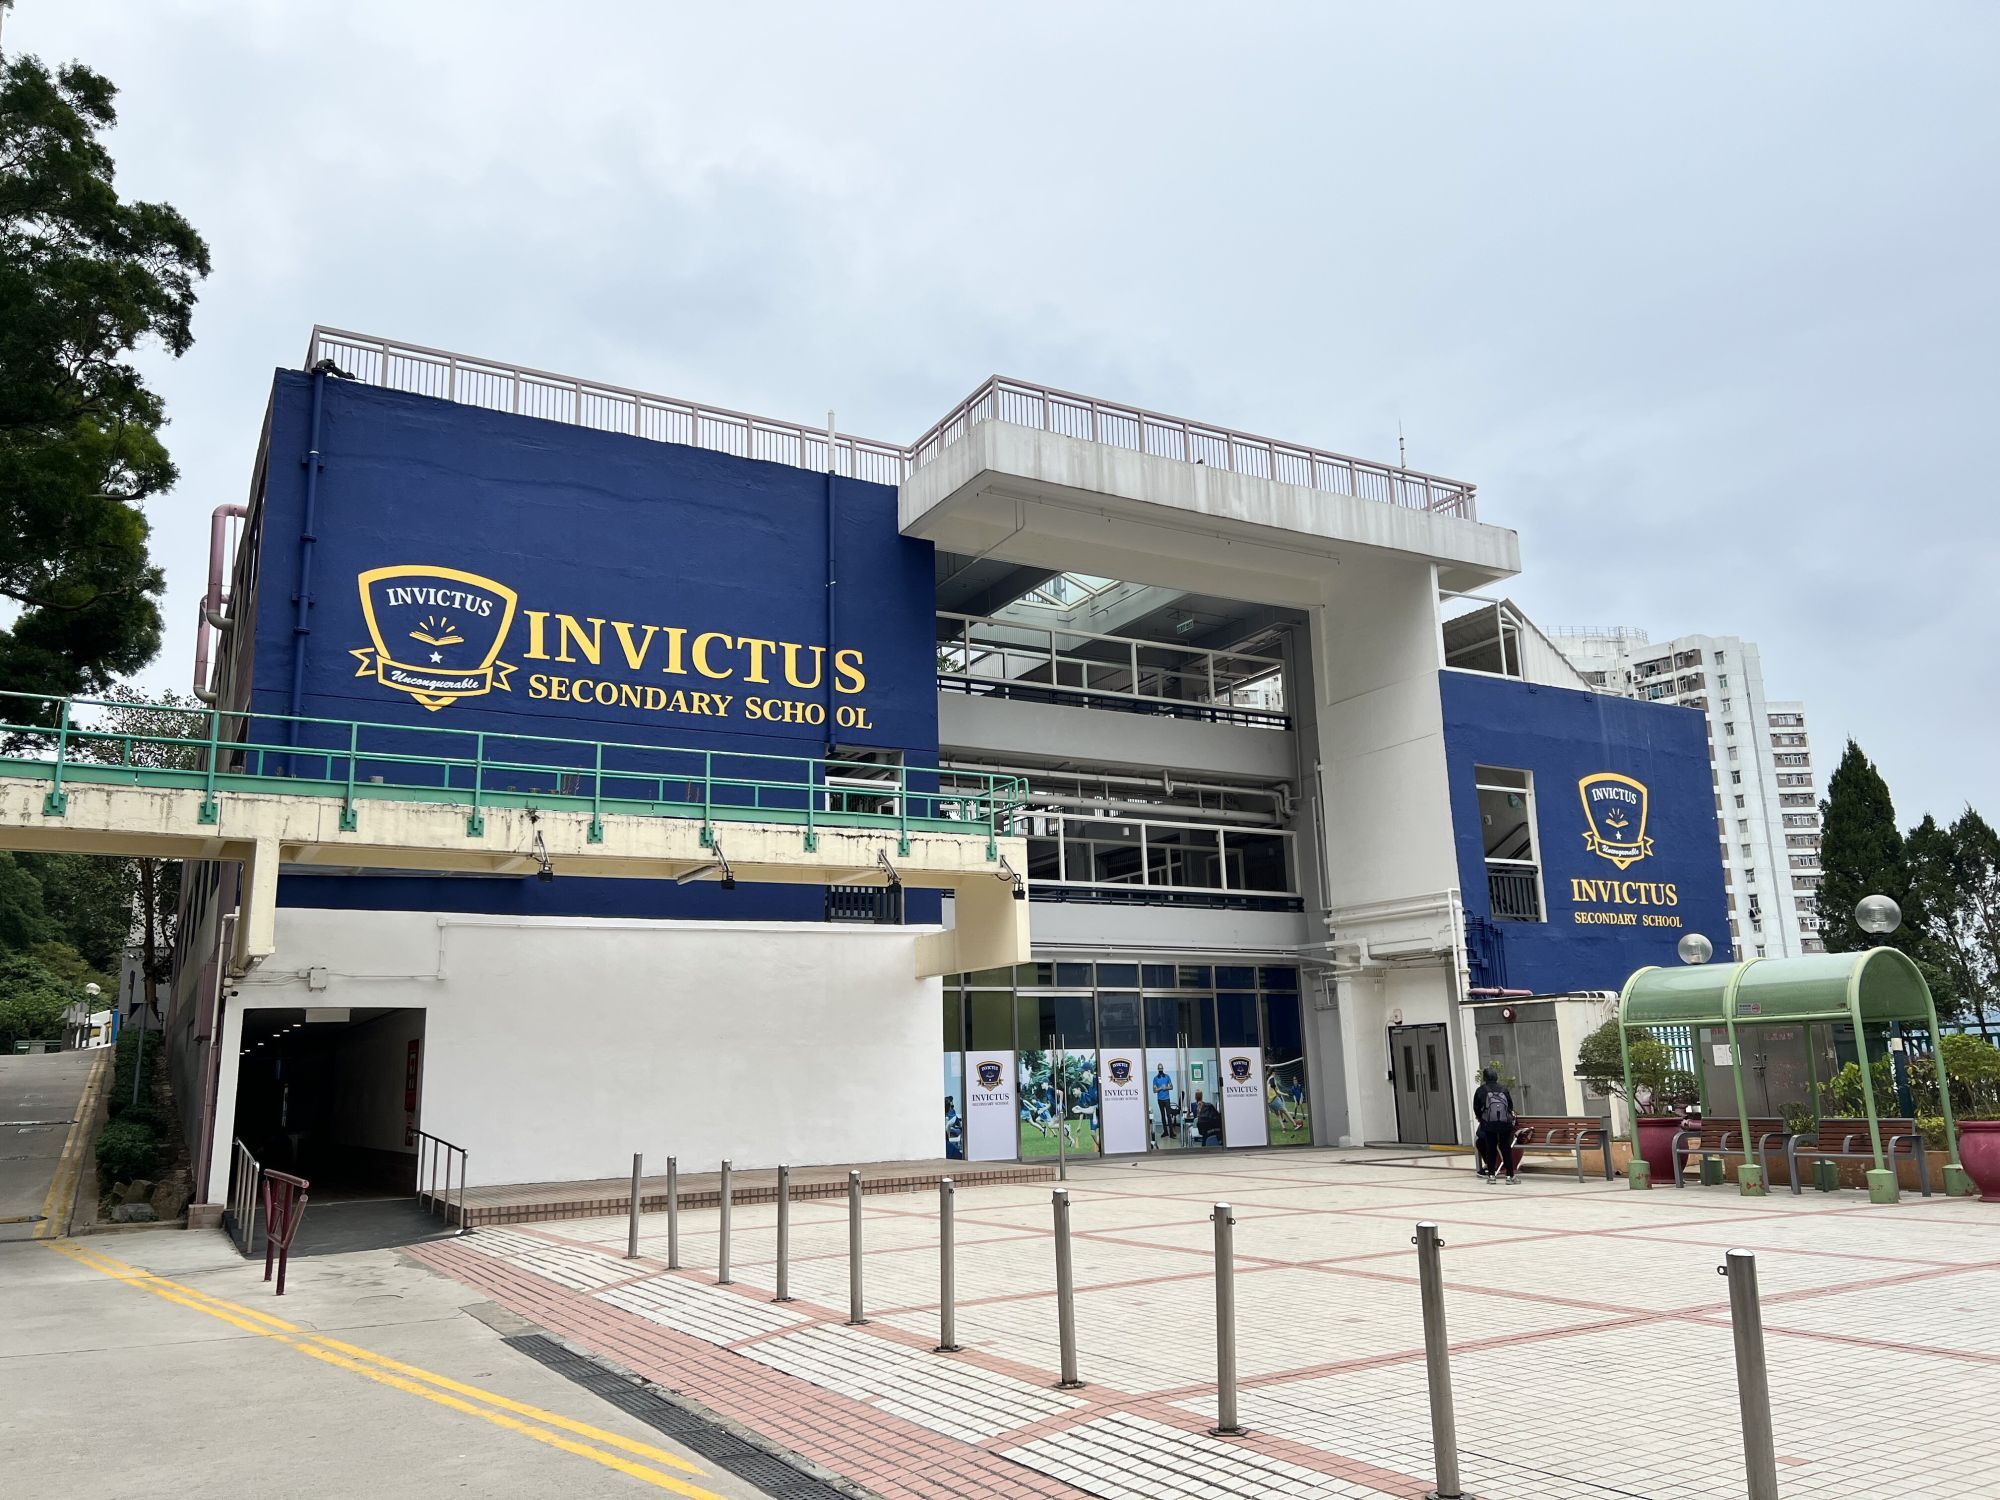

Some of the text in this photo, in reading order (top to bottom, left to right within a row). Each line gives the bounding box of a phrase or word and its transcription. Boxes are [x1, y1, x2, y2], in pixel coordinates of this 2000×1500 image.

[386, 587, 493, 617] INVICTUS
[523, 609, 868, 694] INVICTUS
[391, 670, 480, 690] Unconquerable
[528, 674, 873, 730] SECONDARY SCHOOL
[1591, 787, 1637, 805] INVICTUS
[1570, 878, 1678, 906] INVICTUS
[1574, 911, 1683, 928] SECONDARY SCHOOL
[972, 1093, 1010, 1102] INVICTUS
[1104, 1089, 1139, 1097] INVICTUS
[1226, 1086, 1258, 1094] INVICTUS
